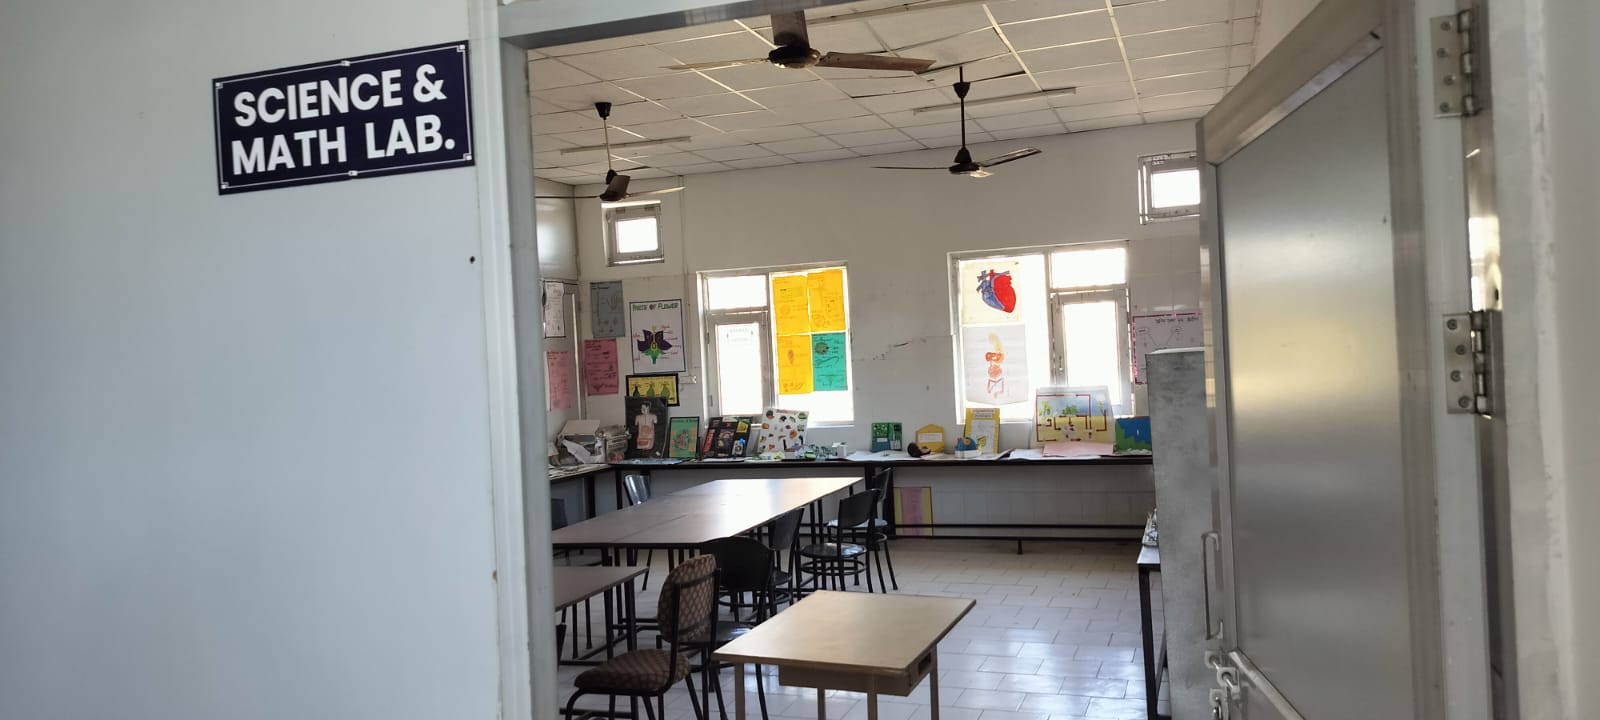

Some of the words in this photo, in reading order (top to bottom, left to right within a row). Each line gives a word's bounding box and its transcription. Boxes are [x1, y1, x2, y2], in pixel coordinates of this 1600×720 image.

[233, 69, 403, 127] SCIENCE
[412, 64, 447, 103] &
[231, 126, 347, 175] MATH
[365, 114, 455, 159] LAB.
